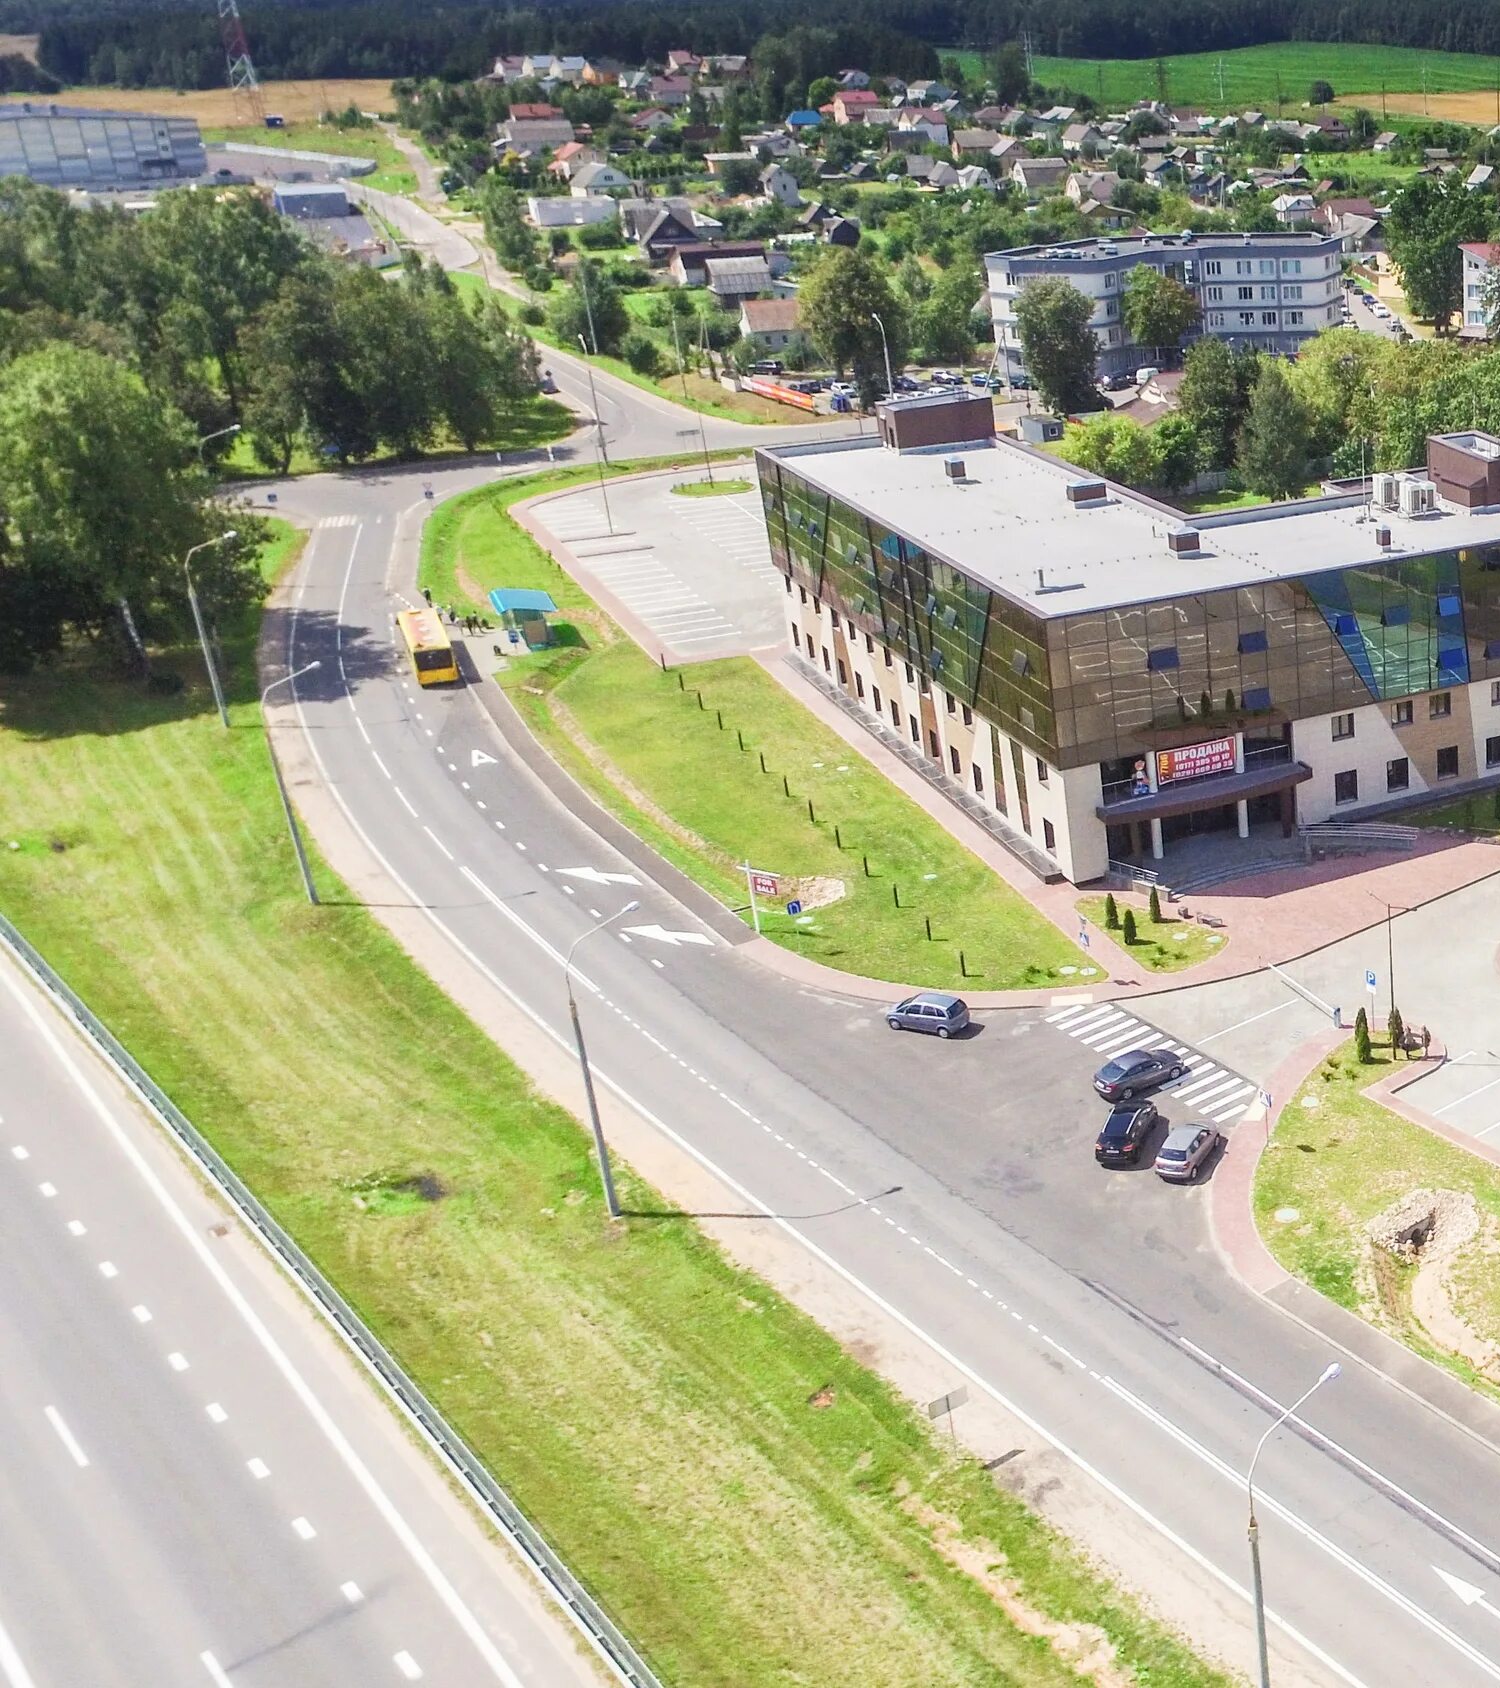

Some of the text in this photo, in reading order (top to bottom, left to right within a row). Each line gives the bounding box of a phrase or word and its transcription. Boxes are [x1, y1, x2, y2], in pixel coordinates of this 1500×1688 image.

[1174, 741, 1230, 762] ПРОДАЖА
[1176, 761, 1194, 771] (017)
[1211, 754, 1220, 763] 10
[1221, 752, 1230, 761] 10
[1173, 769, 1194, 778] (029)
[757, 877, 773, 887] FOR
[756, 884, 775, 893] SALE
